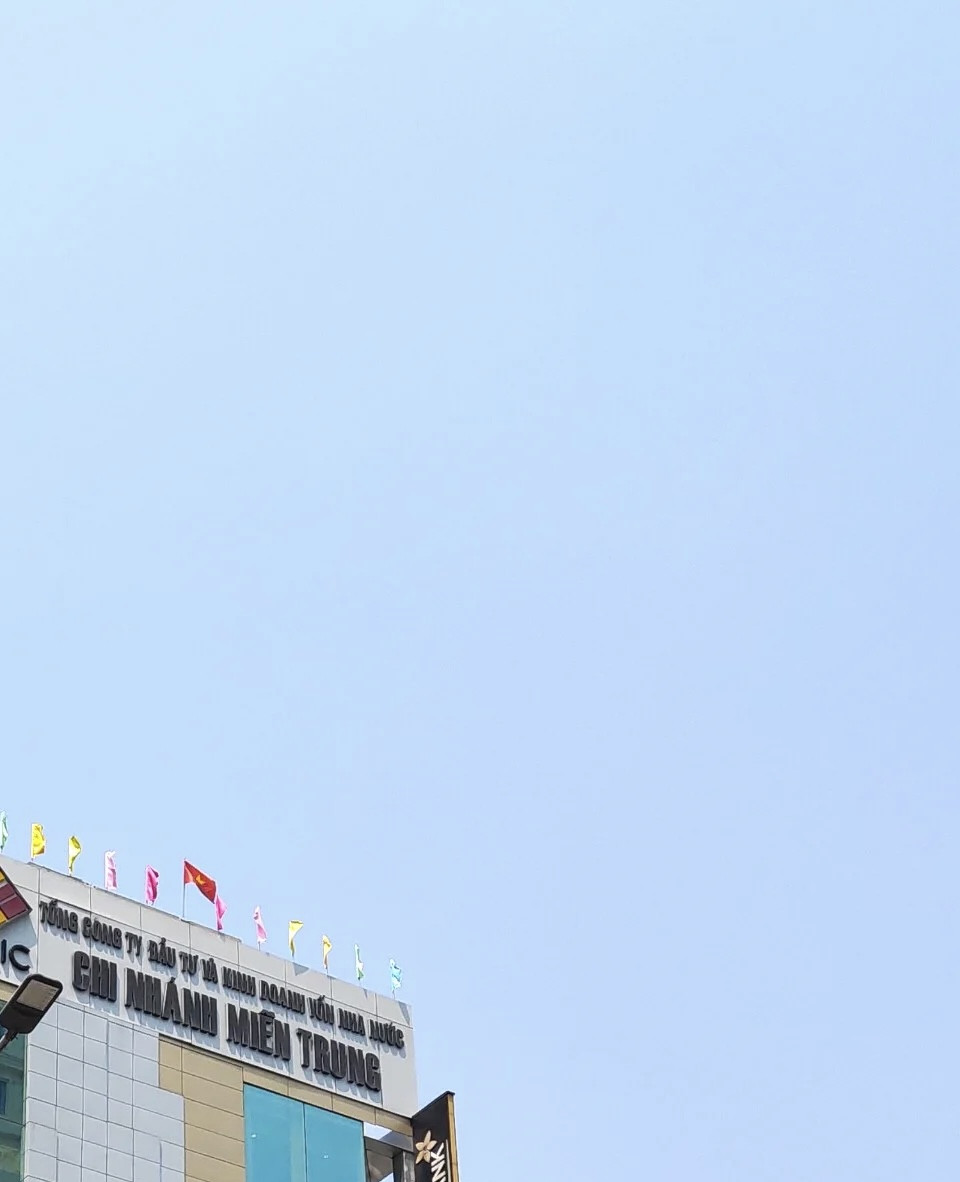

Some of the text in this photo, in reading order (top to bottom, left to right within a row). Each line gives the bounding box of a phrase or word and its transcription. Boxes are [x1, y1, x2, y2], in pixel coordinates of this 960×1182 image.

[72, 951, 117, 1001] CHI
[125, 977, 217, 1036] NHÁNH
[296, 1028, 381, 1092] TRUNG
[125, 931, 143, 957] TY
[221, 966, 256, 997] KINH
[259, 979, 305, 1015] DOANH
[307, 994, 334, 1025] VỐN
